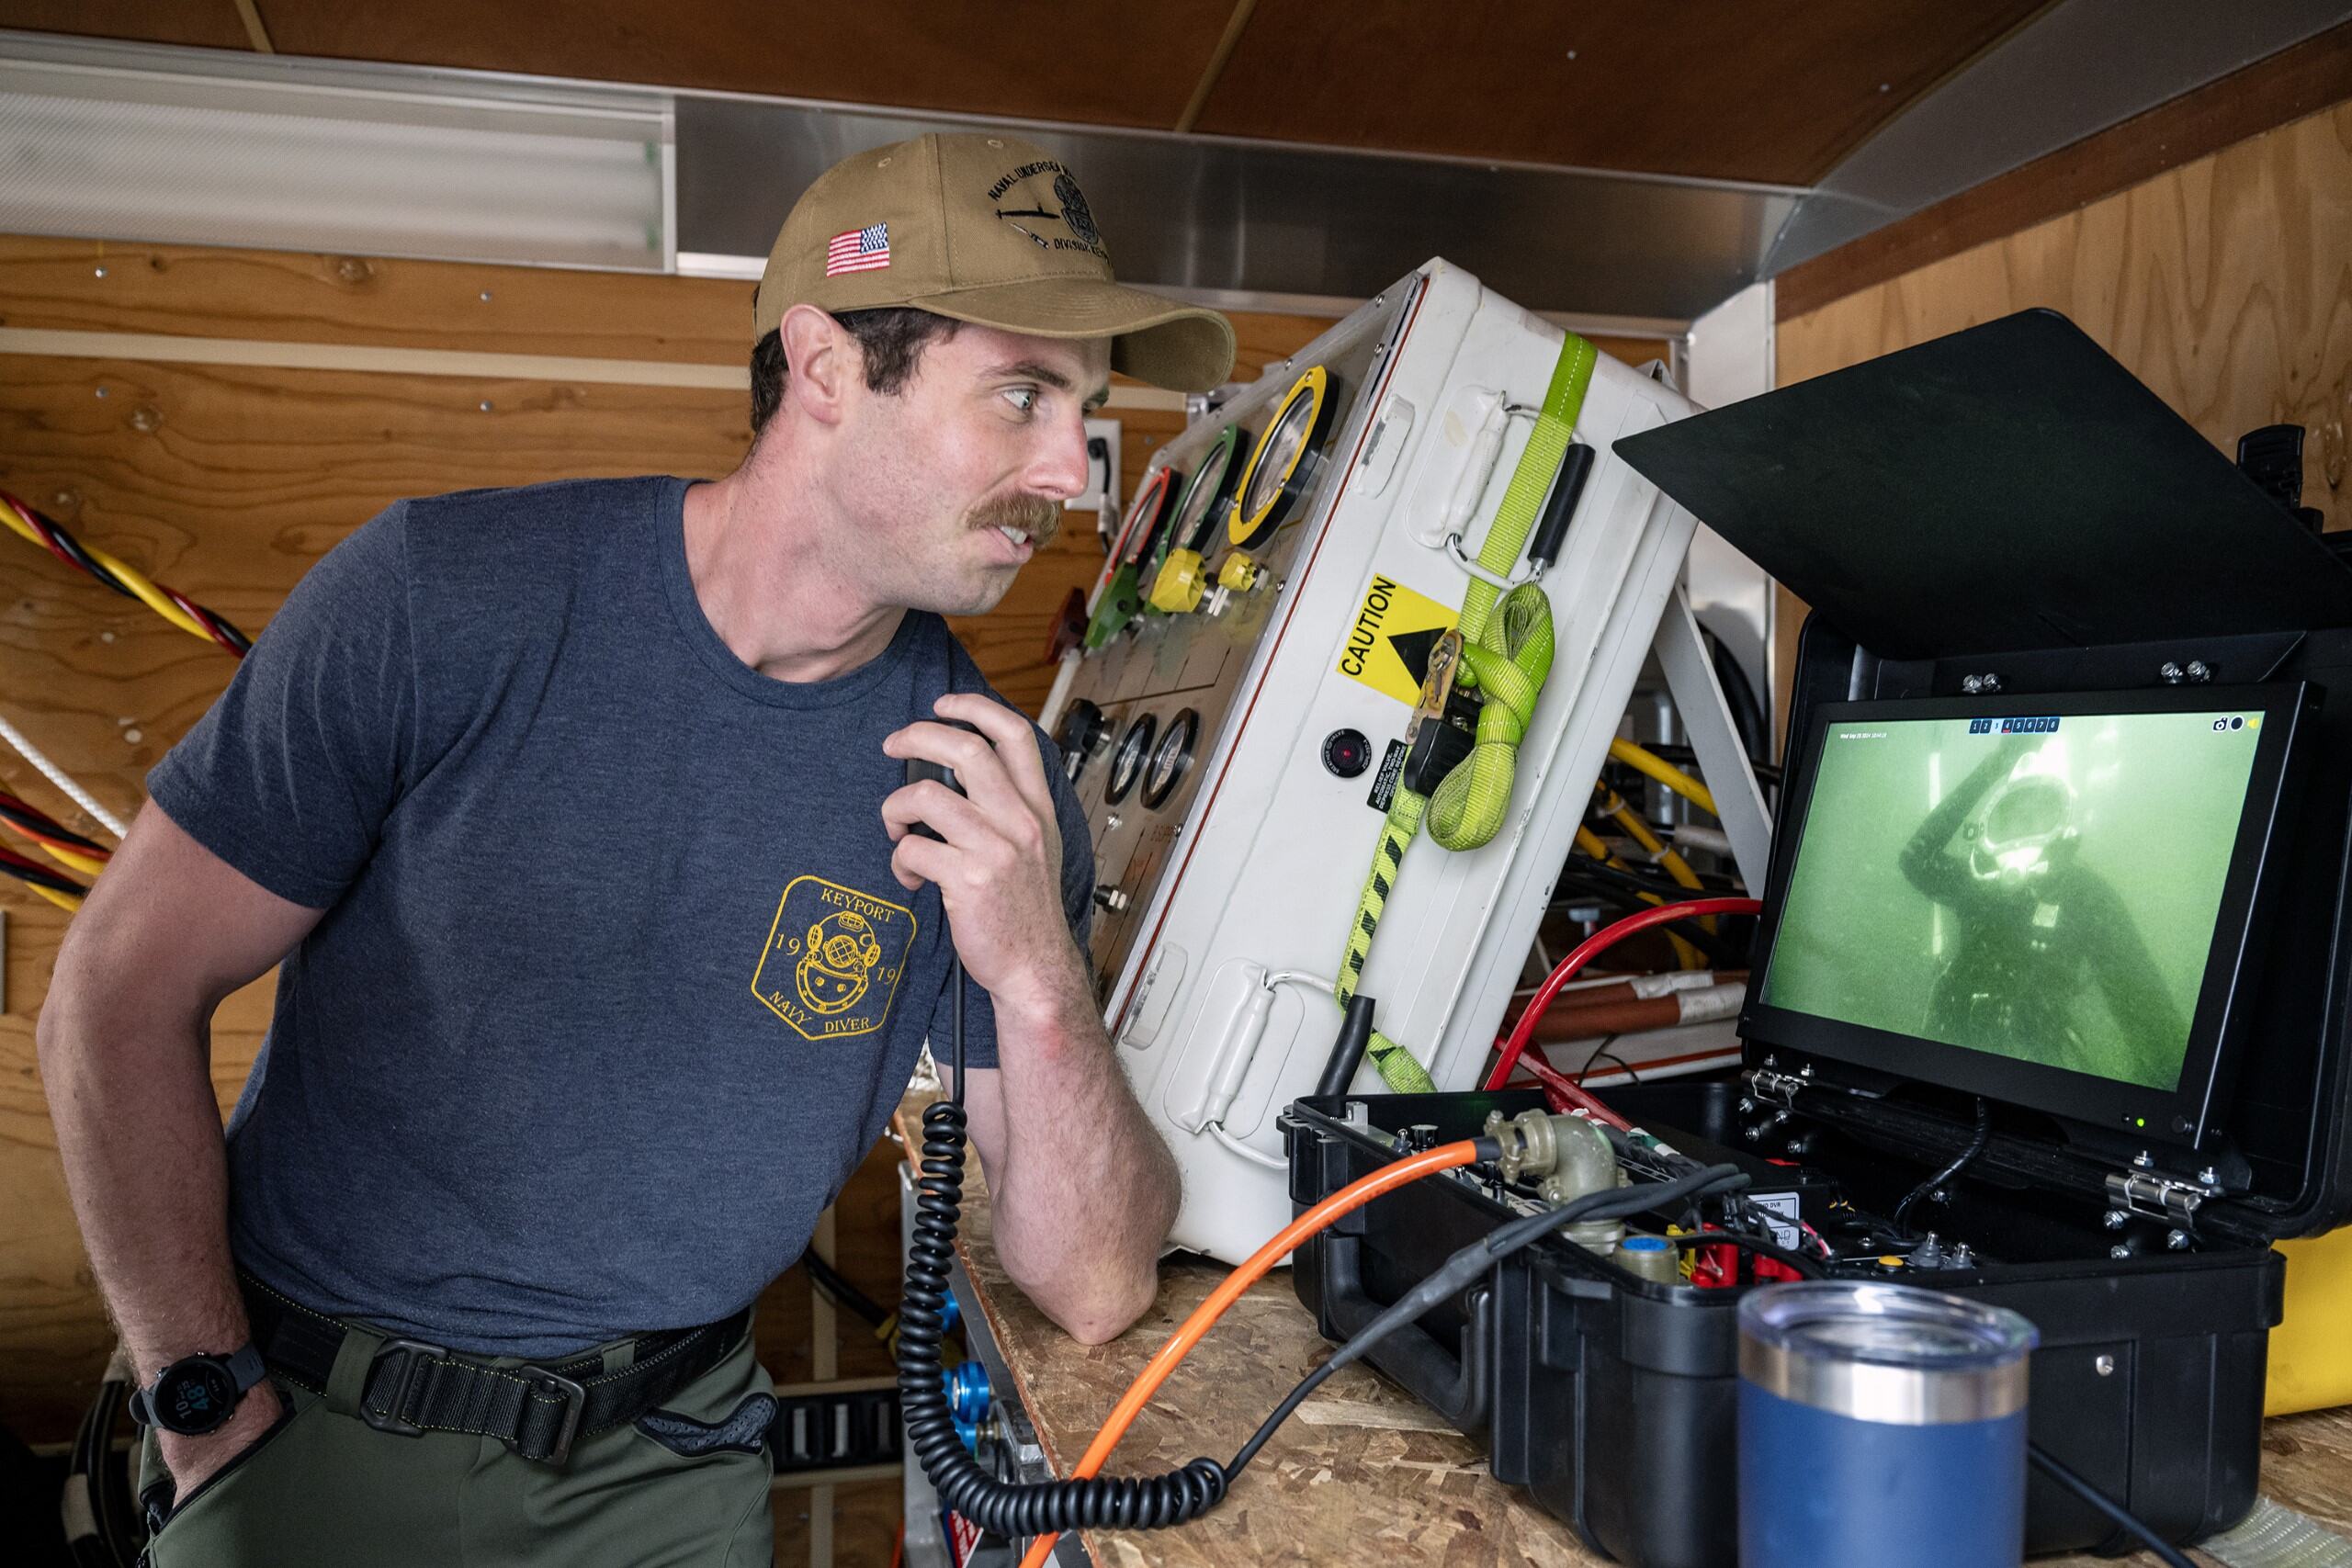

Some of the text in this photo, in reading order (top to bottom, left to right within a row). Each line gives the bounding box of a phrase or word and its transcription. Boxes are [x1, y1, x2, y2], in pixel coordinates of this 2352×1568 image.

[988, 175, 1019, 201] NAVAL
[1341, 577, 1396, 676] CAUTION
[820, 888, 895, 922] KEYPORT
[776, 932, 800, 955] 19
[876, 966, 896, 985] 19
[769, 990, 869, 1033] NAVY DIVER
[175, 1400, 192, 1419] 10
[187, 1384, 210, 1411] 48
